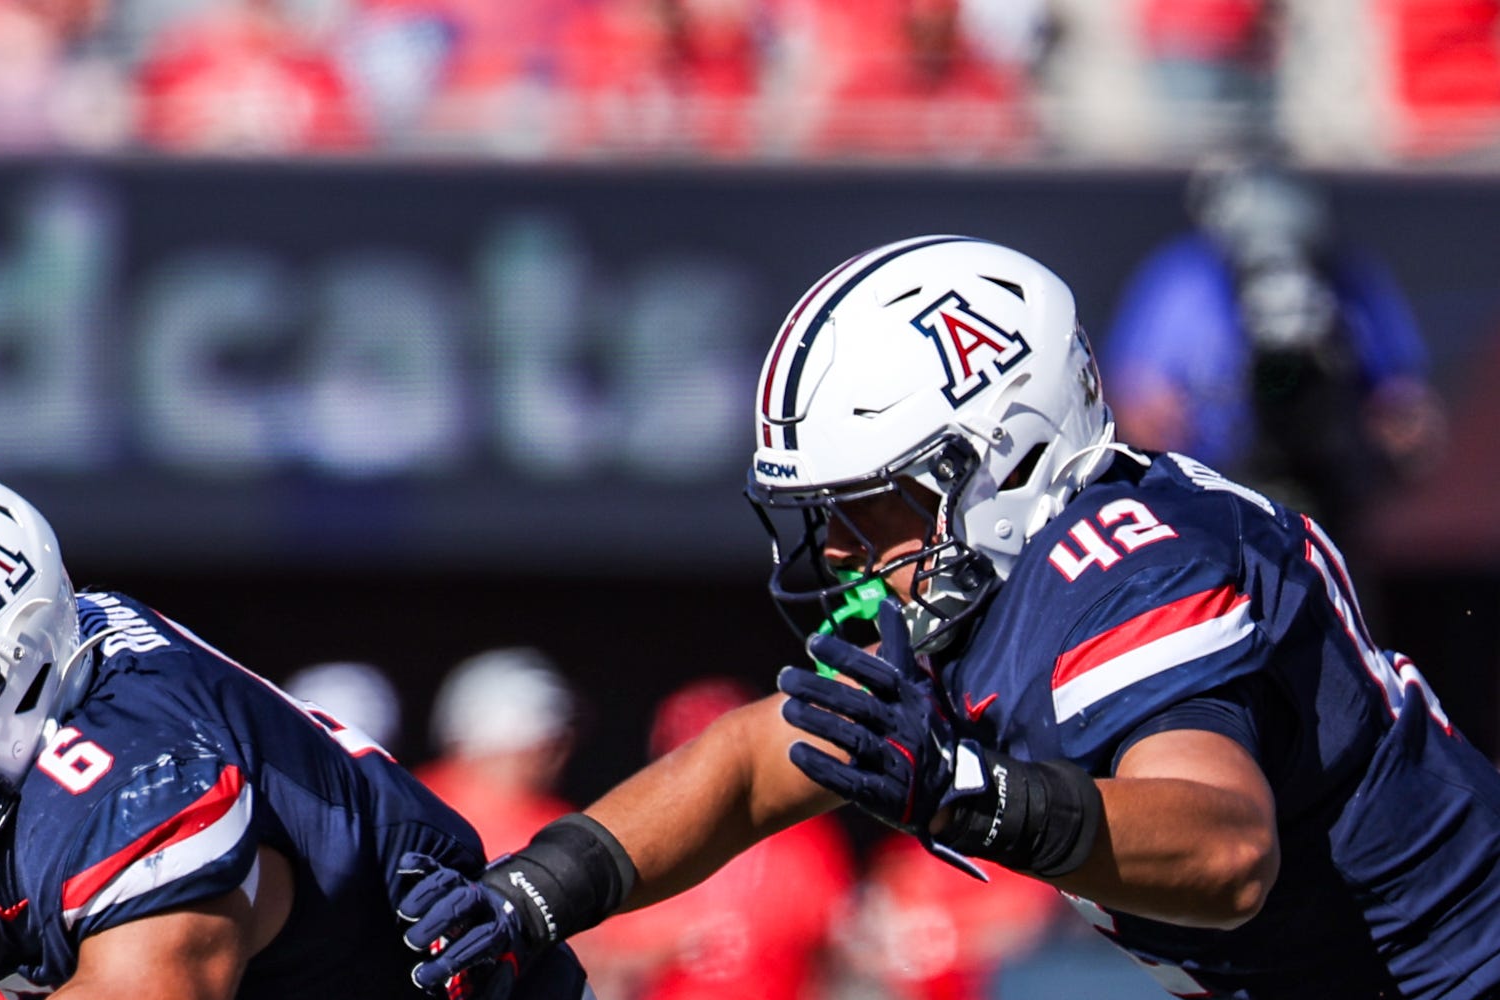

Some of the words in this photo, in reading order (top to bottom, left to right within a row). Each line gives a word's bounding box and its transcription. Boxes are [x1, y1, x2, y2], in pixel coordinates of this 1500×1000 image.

[909, 289, 1032, 410] A
[1047, 497, 1180, 583] 42
[36, 726, 116, 796] 6
